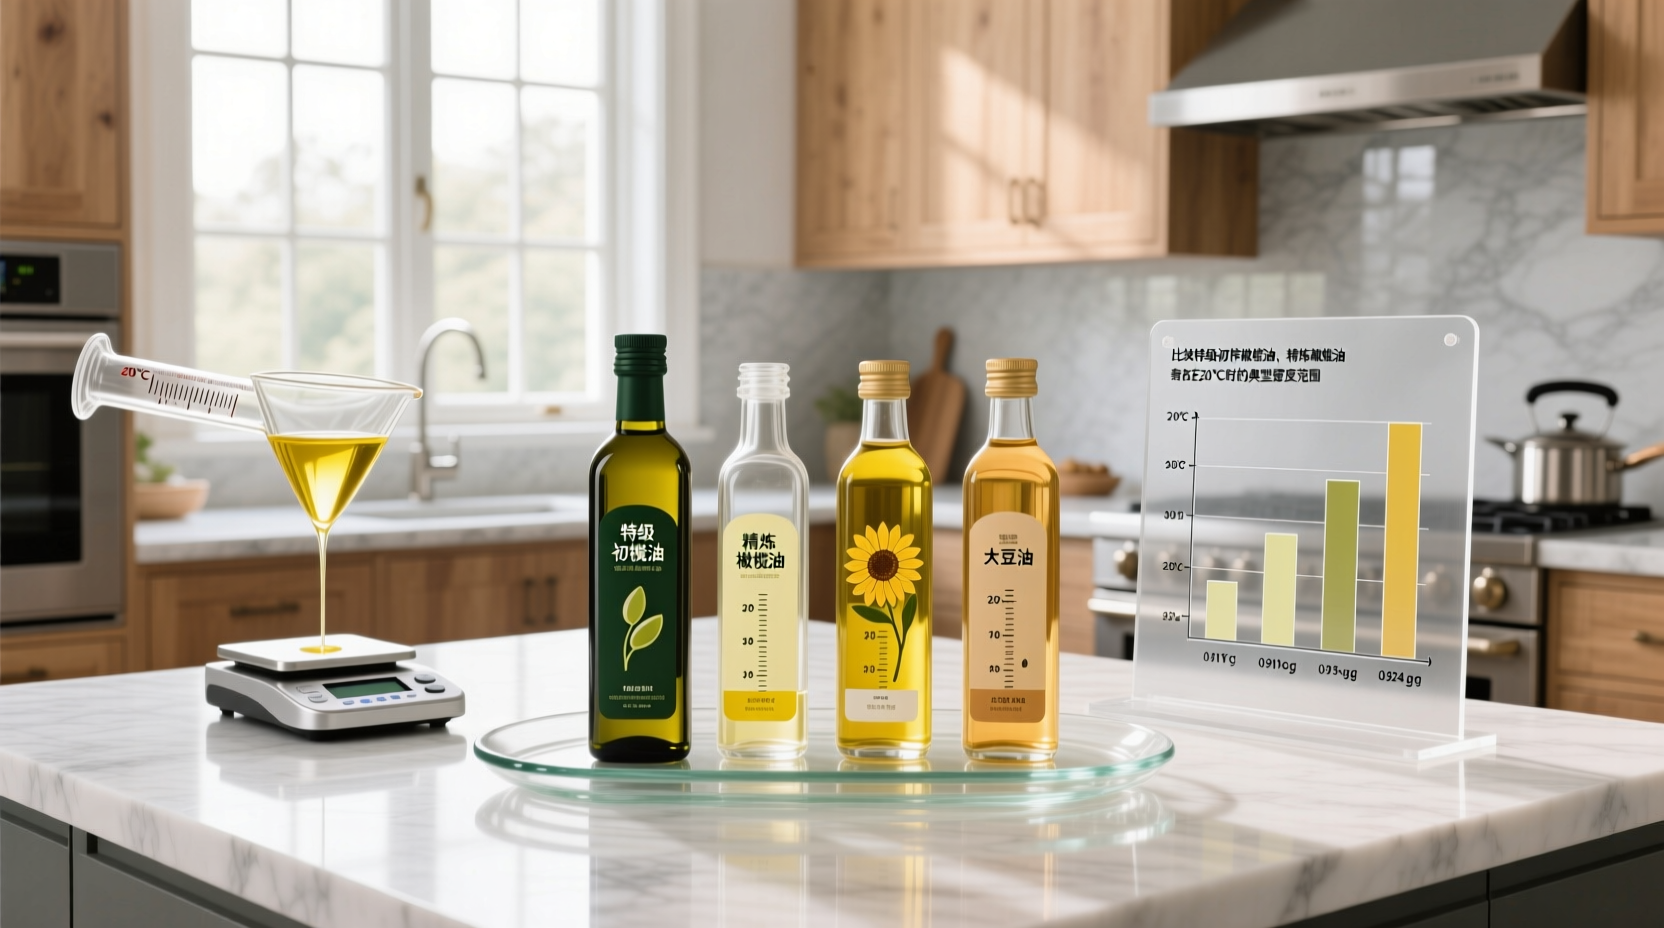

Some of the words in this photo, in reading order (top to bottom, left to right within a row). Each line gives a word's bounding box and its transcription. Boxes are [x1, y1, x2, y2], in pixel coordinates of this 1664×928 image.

[620, 521, 654, 542] 特级
[742, 532, 776, 551] 精炼
[984, 547, 1033, 566] 大豆油
[987, 595, 1001, 604] 20
